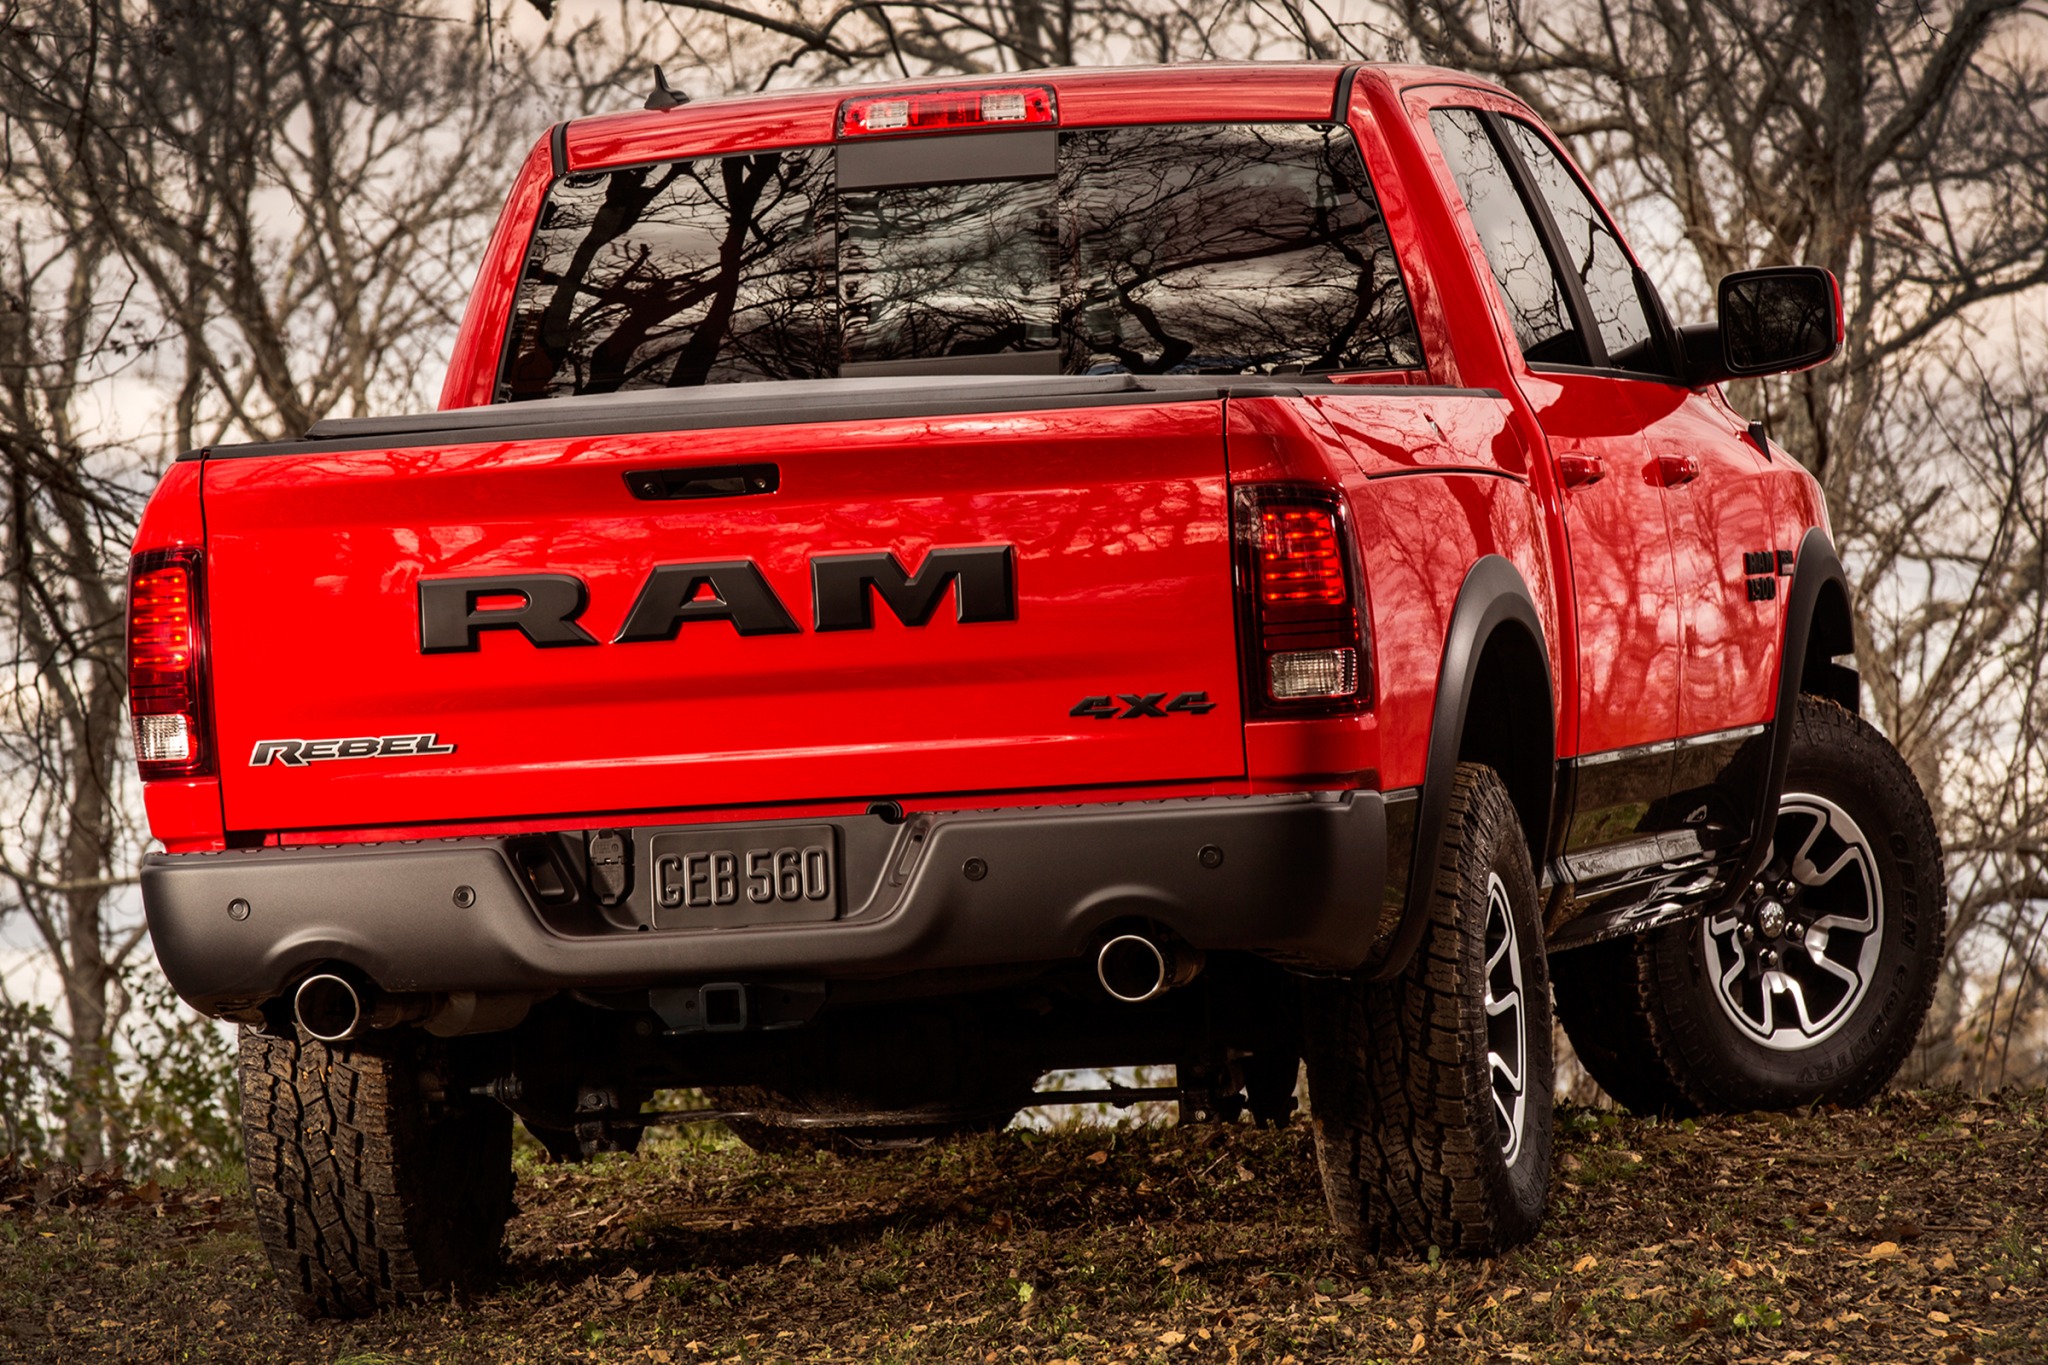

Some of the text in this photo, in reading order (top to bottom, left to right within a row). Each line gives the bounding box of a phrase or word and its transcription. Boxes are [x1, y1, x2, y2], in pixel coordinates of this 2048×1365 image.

[416, 544, 1019, 654] RAM
[248, 733, 456, 767] REBEL
[655, 844, 829, 909] GEB 560
[1889, 831, 1920, 952] OPEN
